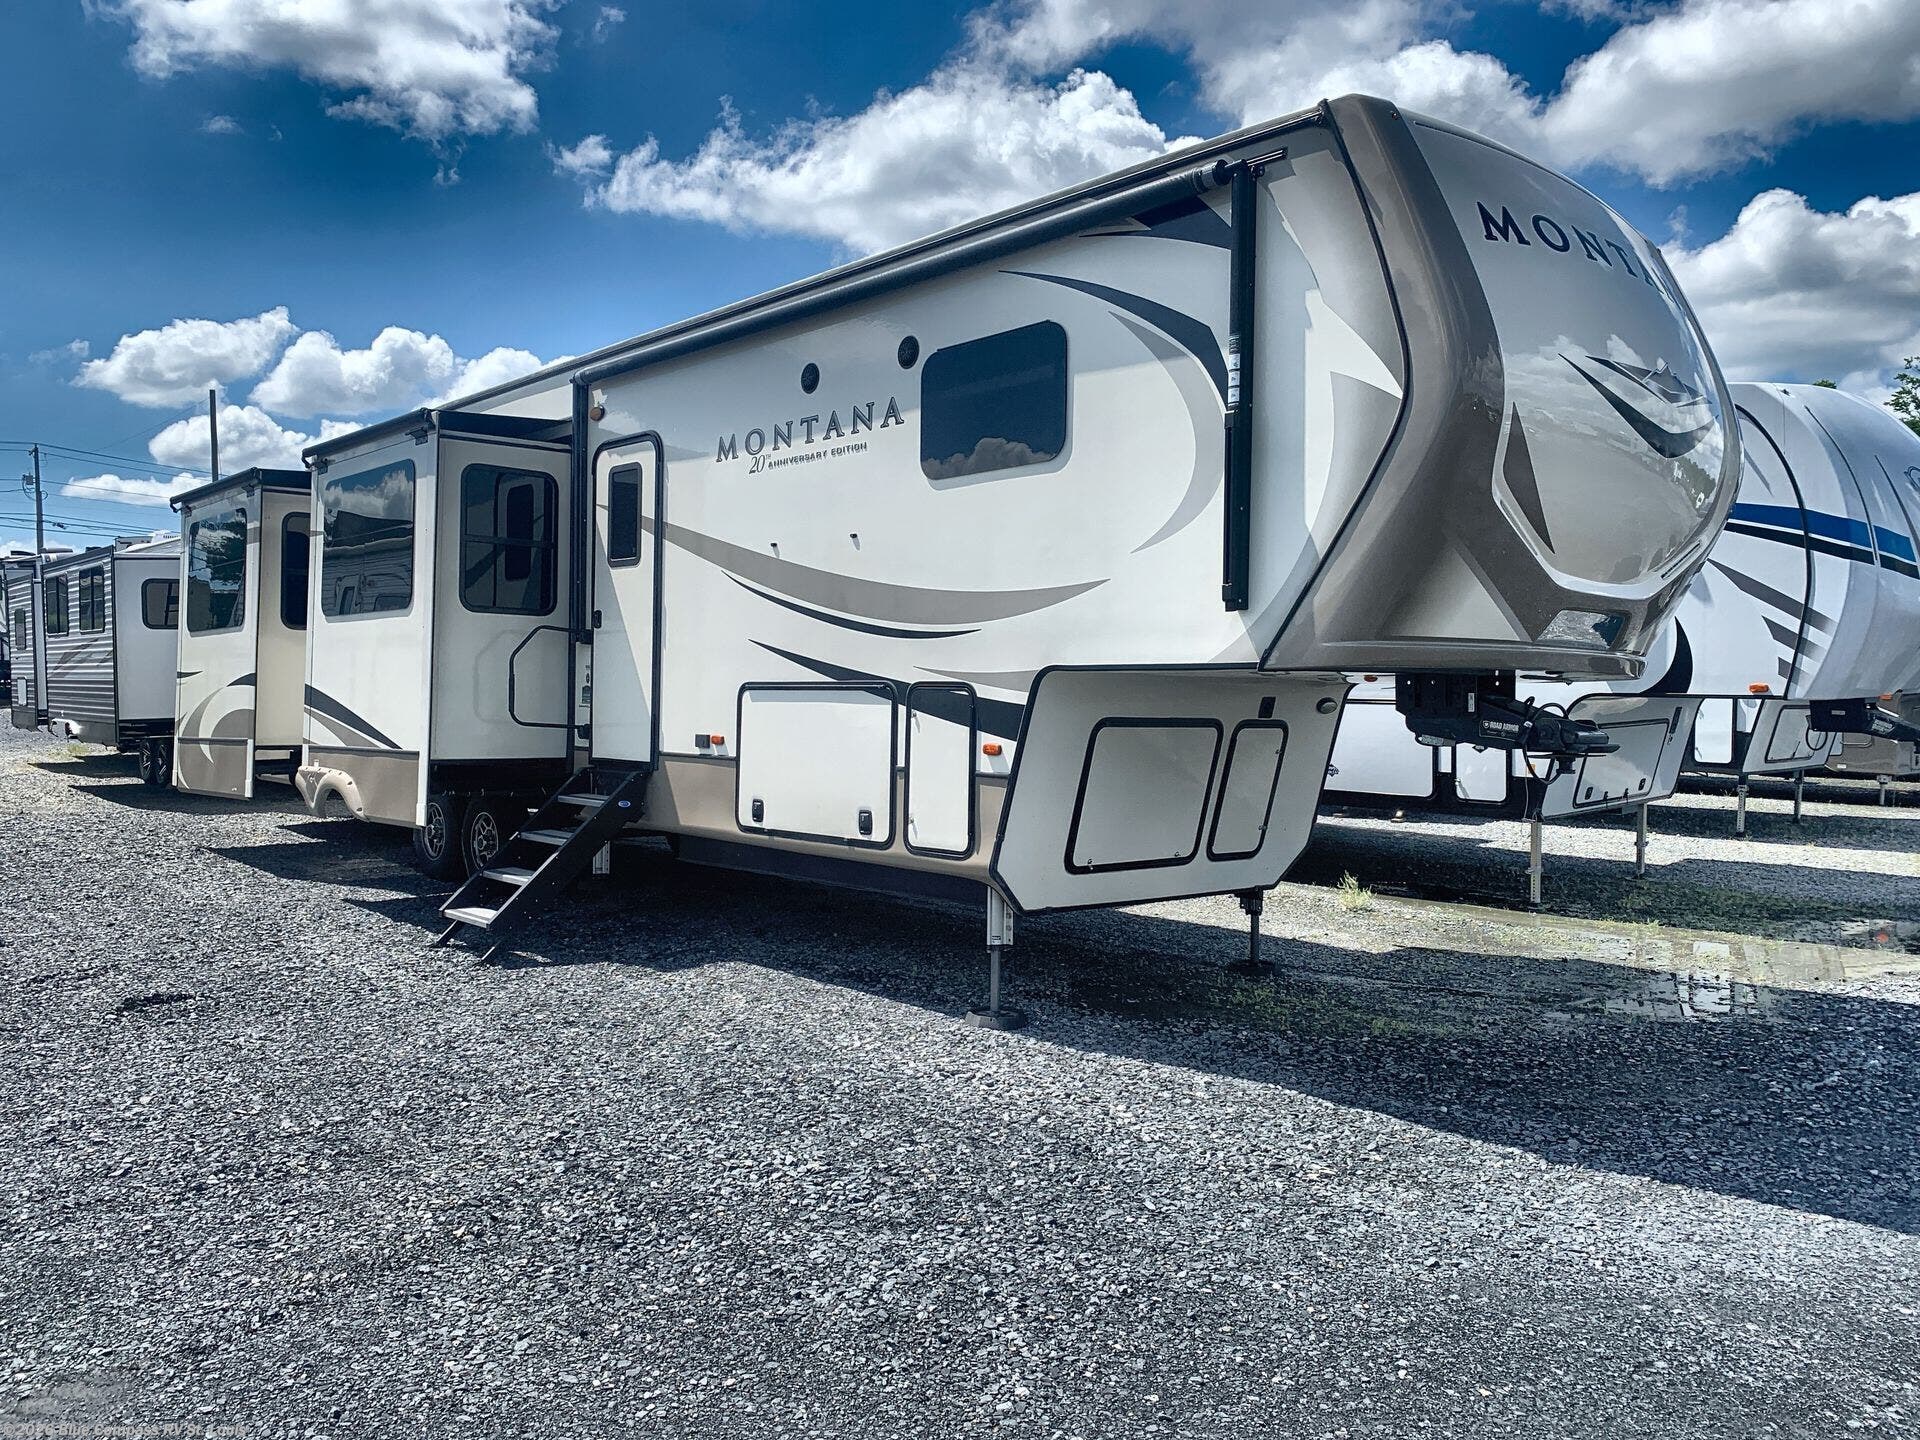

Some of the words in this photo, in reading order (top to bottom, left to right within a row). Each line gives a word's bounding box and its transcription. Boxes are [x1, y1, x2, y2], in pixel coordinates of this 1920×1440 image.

[1476, 201, 1675, 304] MONTA
[716, 397, 904, 462] MONTANA
[768, 450, 827, 469] ANNIVERSARY
[831, 441, 867, 456] EDITION
